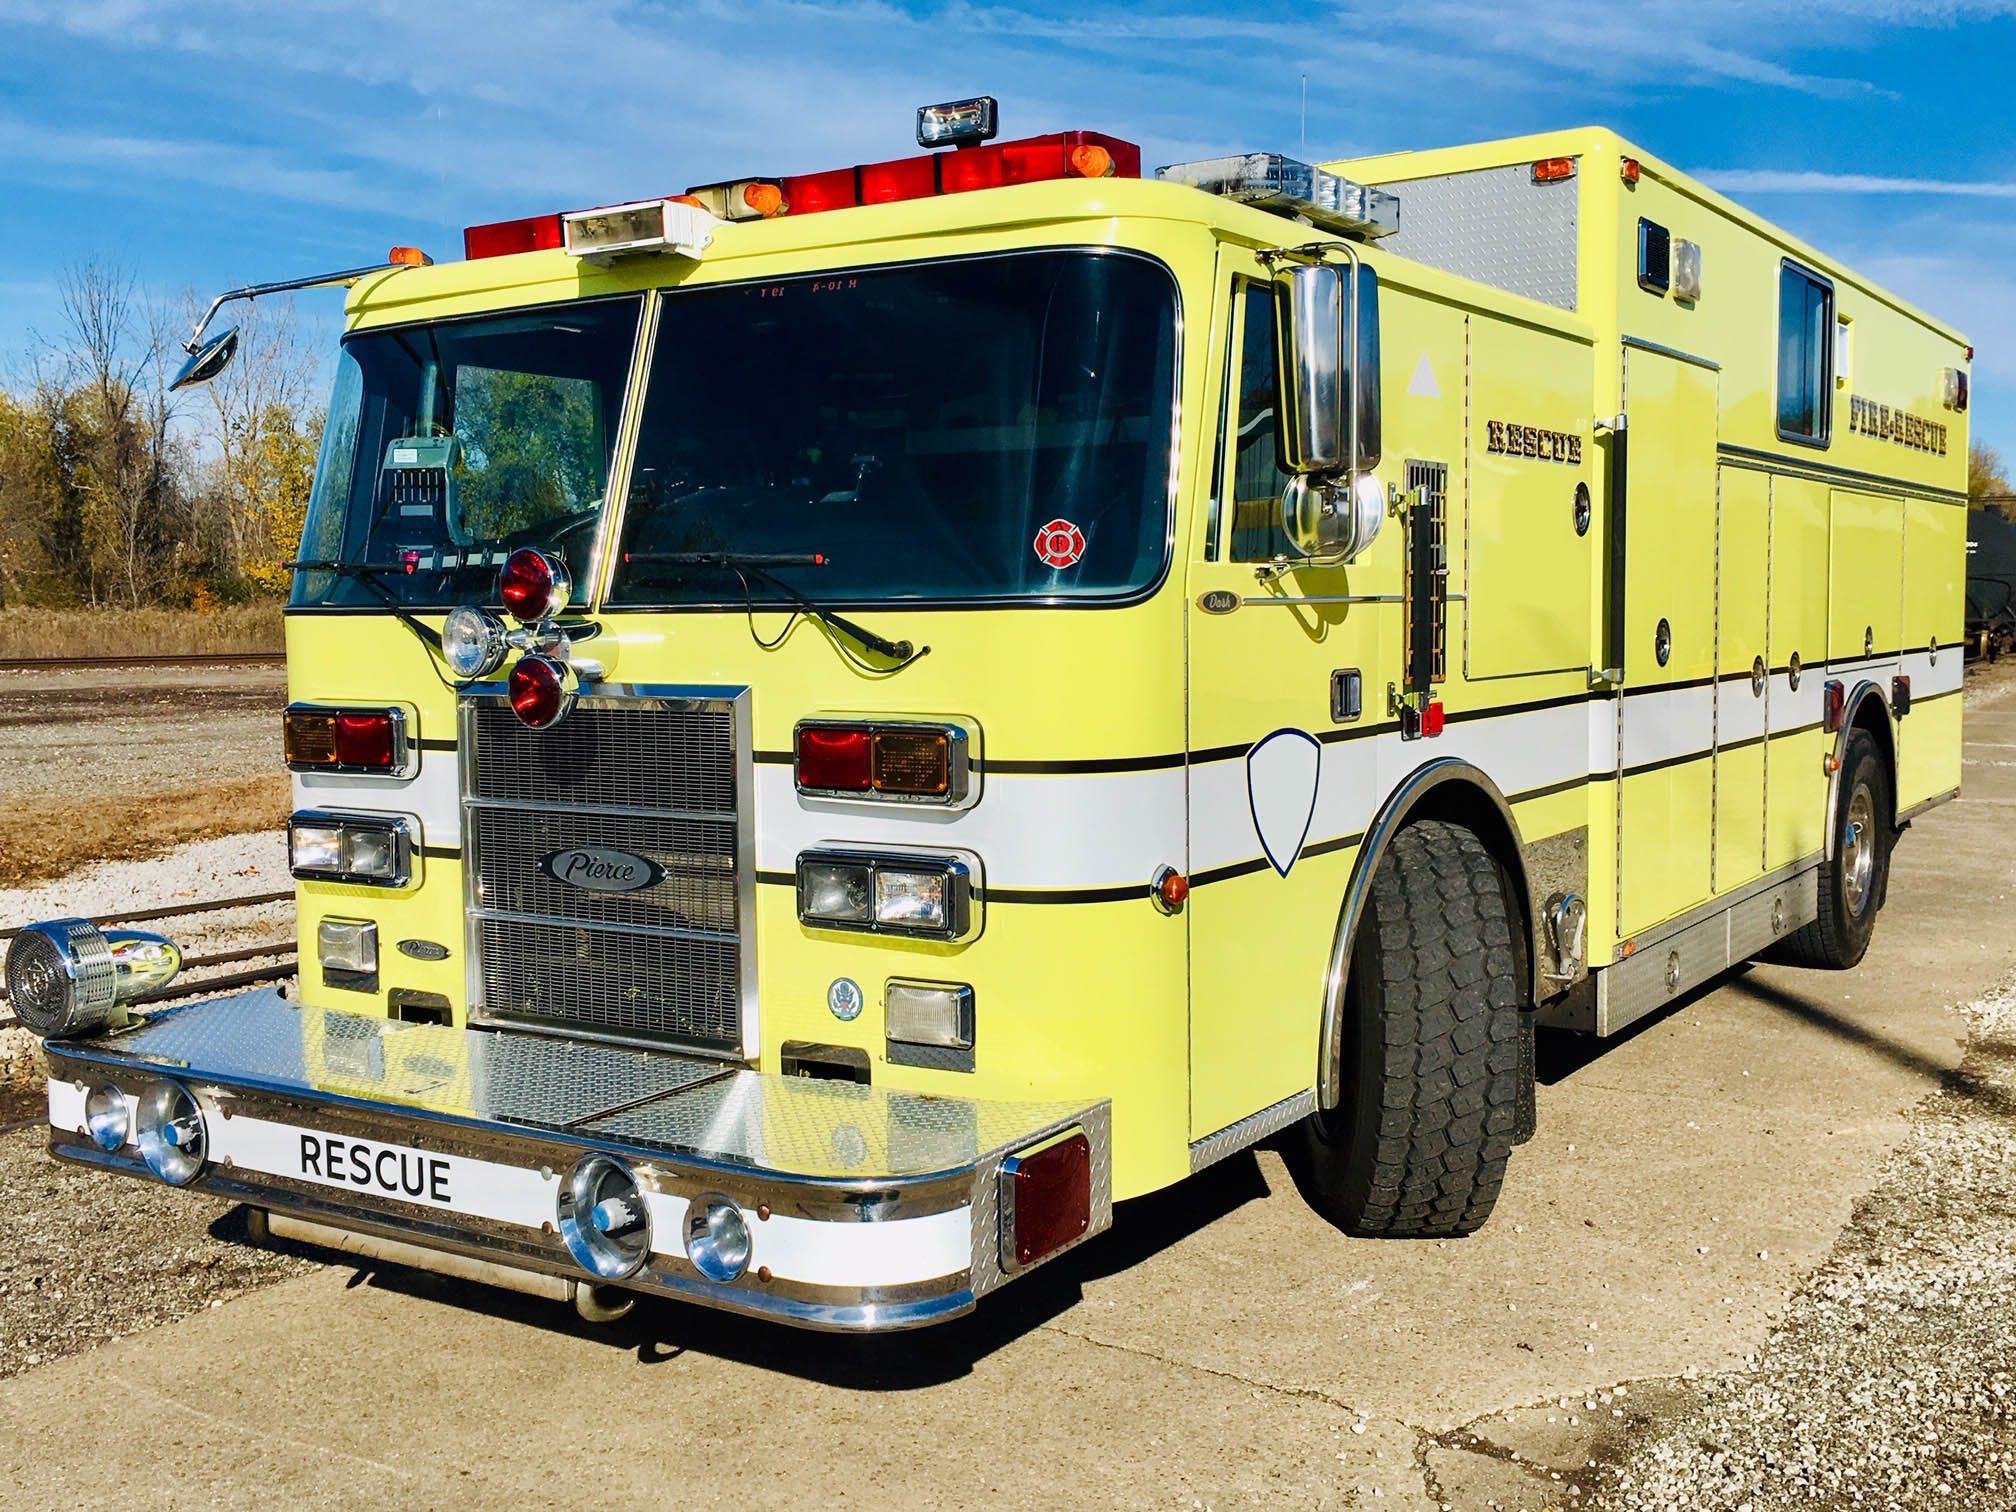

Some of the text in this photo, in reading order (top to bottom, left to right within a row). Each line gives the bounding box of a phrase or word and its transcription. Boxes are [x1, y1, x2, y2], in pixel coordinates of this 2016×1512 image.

[1486, 419, 1582, 465] RESCUE
[1209, 594, 1231, 609] Dash
[565, 852, 636, 881] Pierce
[300, 1134, 452, 1203] RESCUE
